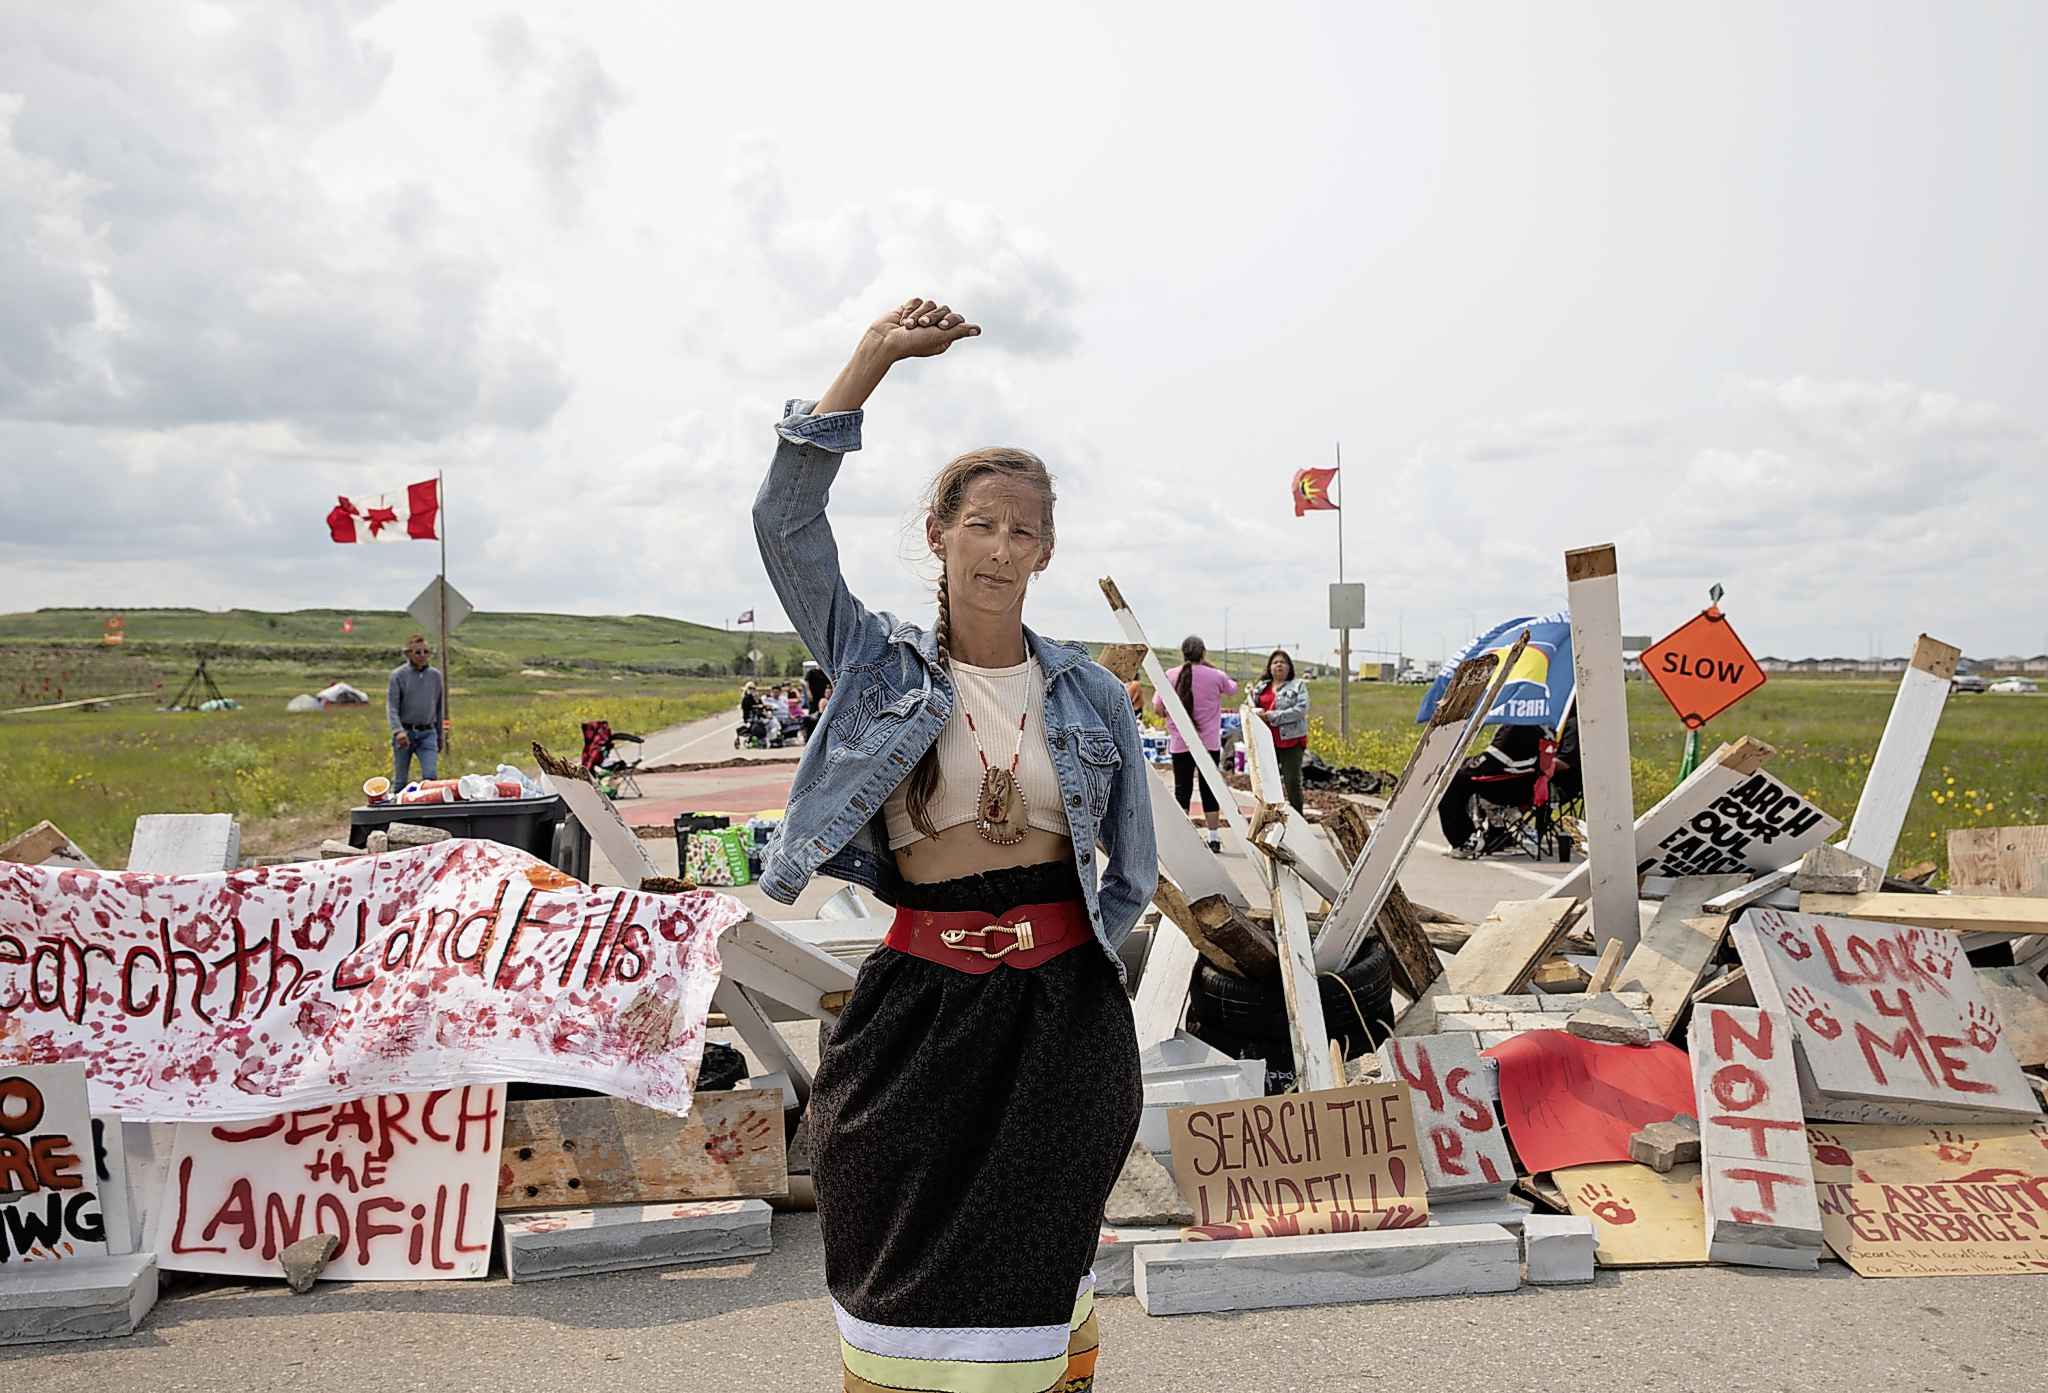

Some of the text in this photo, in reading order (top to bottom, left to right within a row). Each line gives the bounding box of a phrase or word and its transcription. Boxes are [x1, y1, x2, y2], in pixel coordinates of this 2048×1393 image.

[1662, 651, 1745, 685] SLOW
[1727, 770, 1824, 839] ARCH
[1688, 811, 1752, 860] OUL
[1814, 923, 1951, 998] LOOK
[1870, 988, 1925, 1040] 4
[1854, 1021, 1999, 1095] ME
[1187, 1095, 1408, 1177] SEARCH THE
[1820, 1184, 2035, 1215] WE ARE NOT
